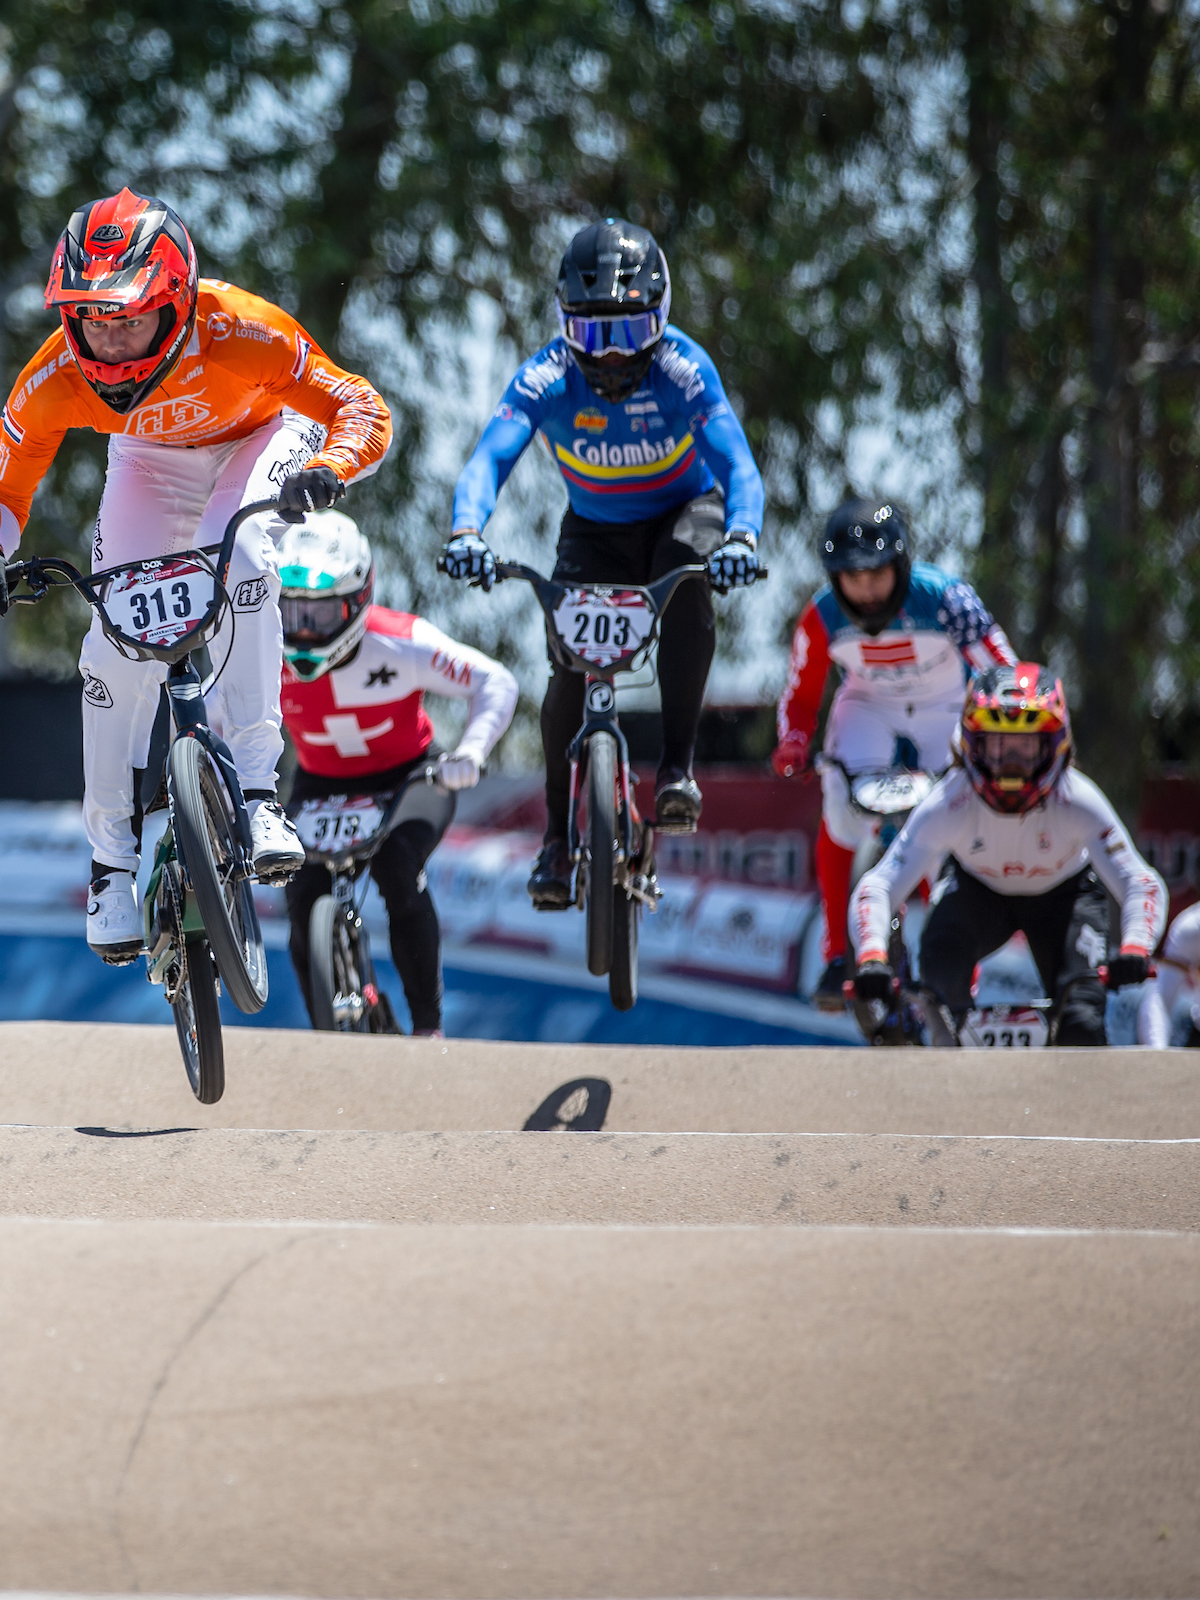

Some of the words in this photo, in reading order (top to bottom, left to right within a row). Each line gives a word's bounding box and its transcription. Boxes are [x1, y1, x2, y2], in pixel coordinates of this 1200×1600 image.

[235, 328, 274, 345] LOTERIJ
[236, 319, 291, 346] NEDERLANDSE
[24, 358, 57, 396] TIRE
[572, 434, 676, 467] Colombia
[139, 574, 155, 583] UCI
[141, 560, 164, 571] box
[130, 581, 192, 630] 313
[573, 612, 631, 646] 203
